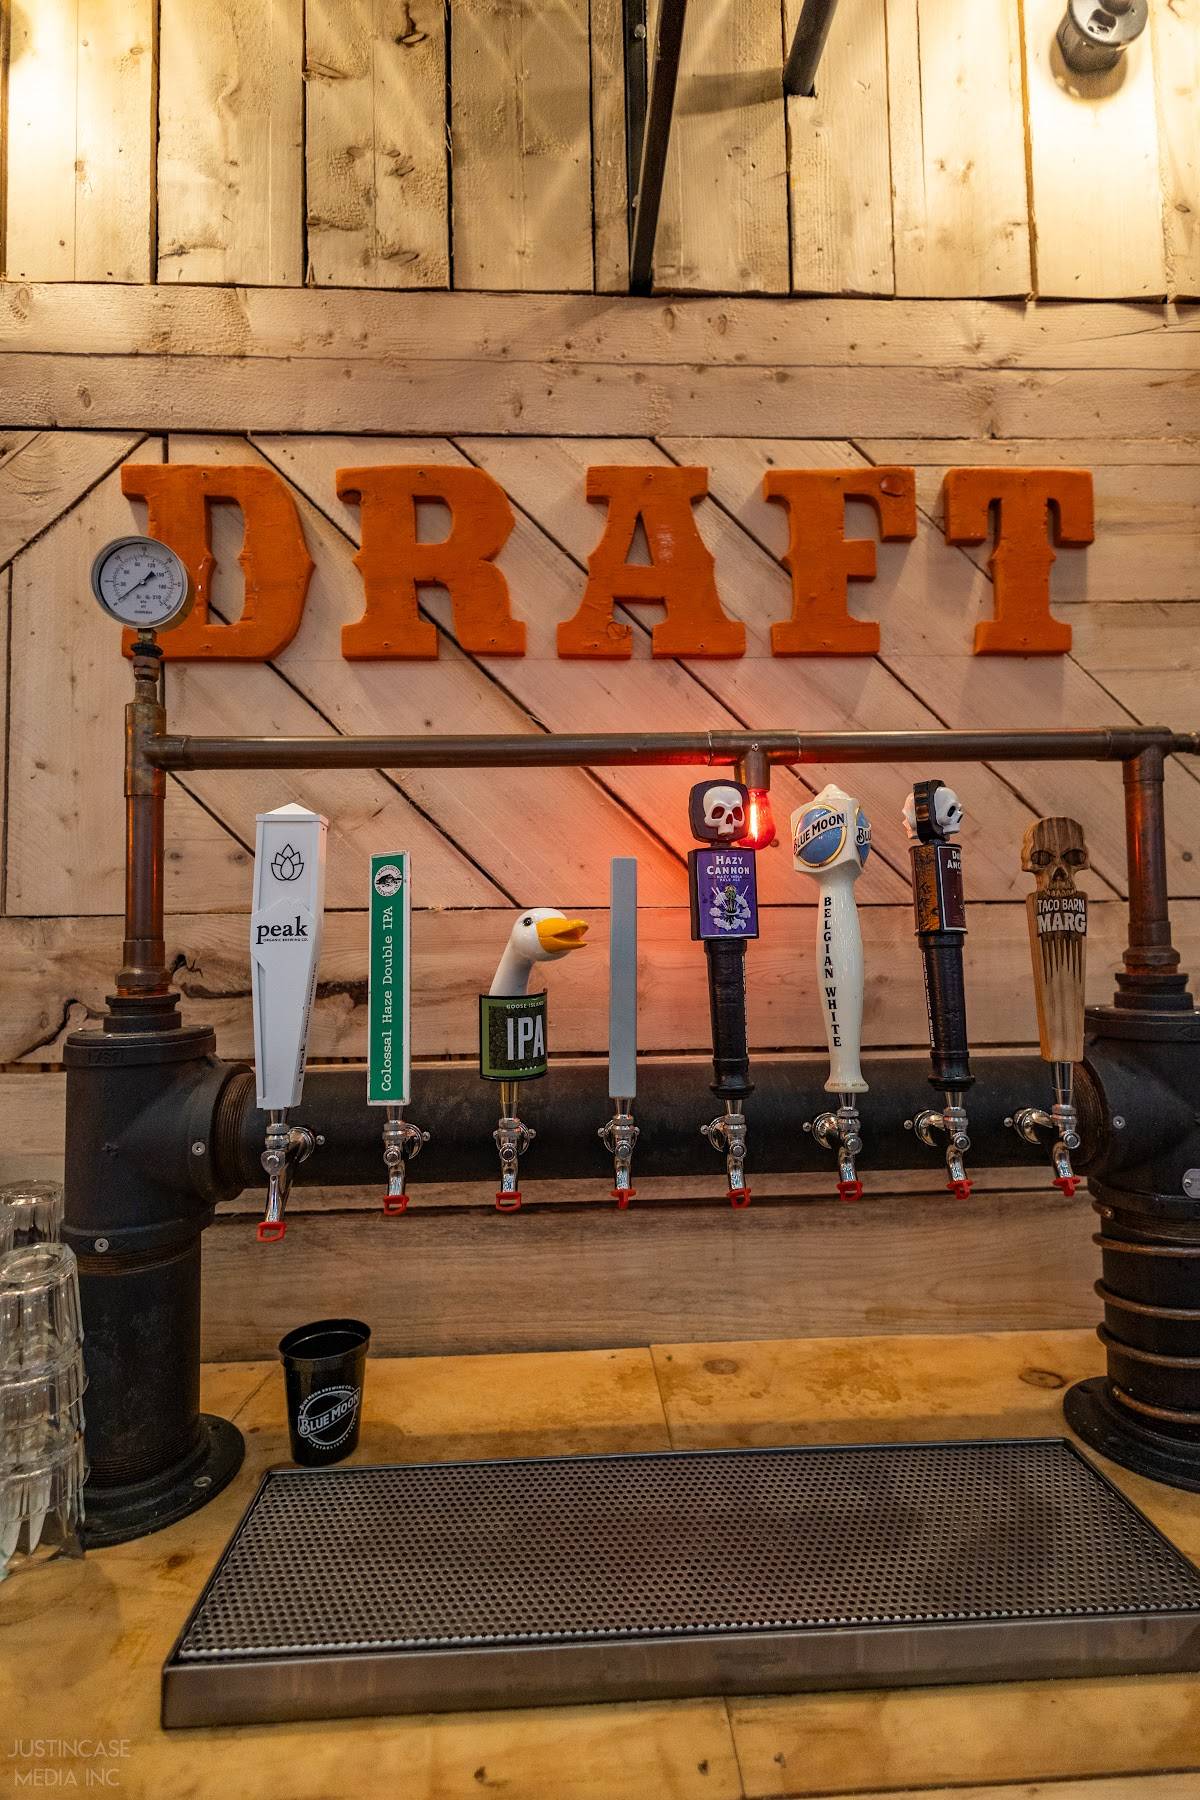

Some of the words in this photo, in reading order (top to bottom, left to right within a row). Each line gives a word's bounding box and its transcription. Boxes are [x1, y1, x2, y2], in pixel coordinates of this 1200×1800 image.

[122, 464, 1094, 662] DRAFT
[793, 830, 811, 856] BLUE
[811, 813, 845, 836] MOON
[706, 866, 750, 874] CANNON
[716, 856, 743, 864] HAZY
[382, 905, 394, 931] IPA
[1037, 899, 1060, 913] TACO
[1062, 898, 1085, 913] BARN
[1037, 912, 1086, 934] MARG
[255, 915, 309, 945] peak
[823, 896, 834, 979] BELGIAN
[382, 935, 393, 985] Double
[382, 990, 393, 1024] Haze
[825, 986, 842, 1047] WHITE
[507, 1015, 544, 1060] IPA
[381, 1029, 392, 1092] Colossal
[300, 1414, 330, 1435] BLUE
[331, 1391, 359, 1421] MOON
